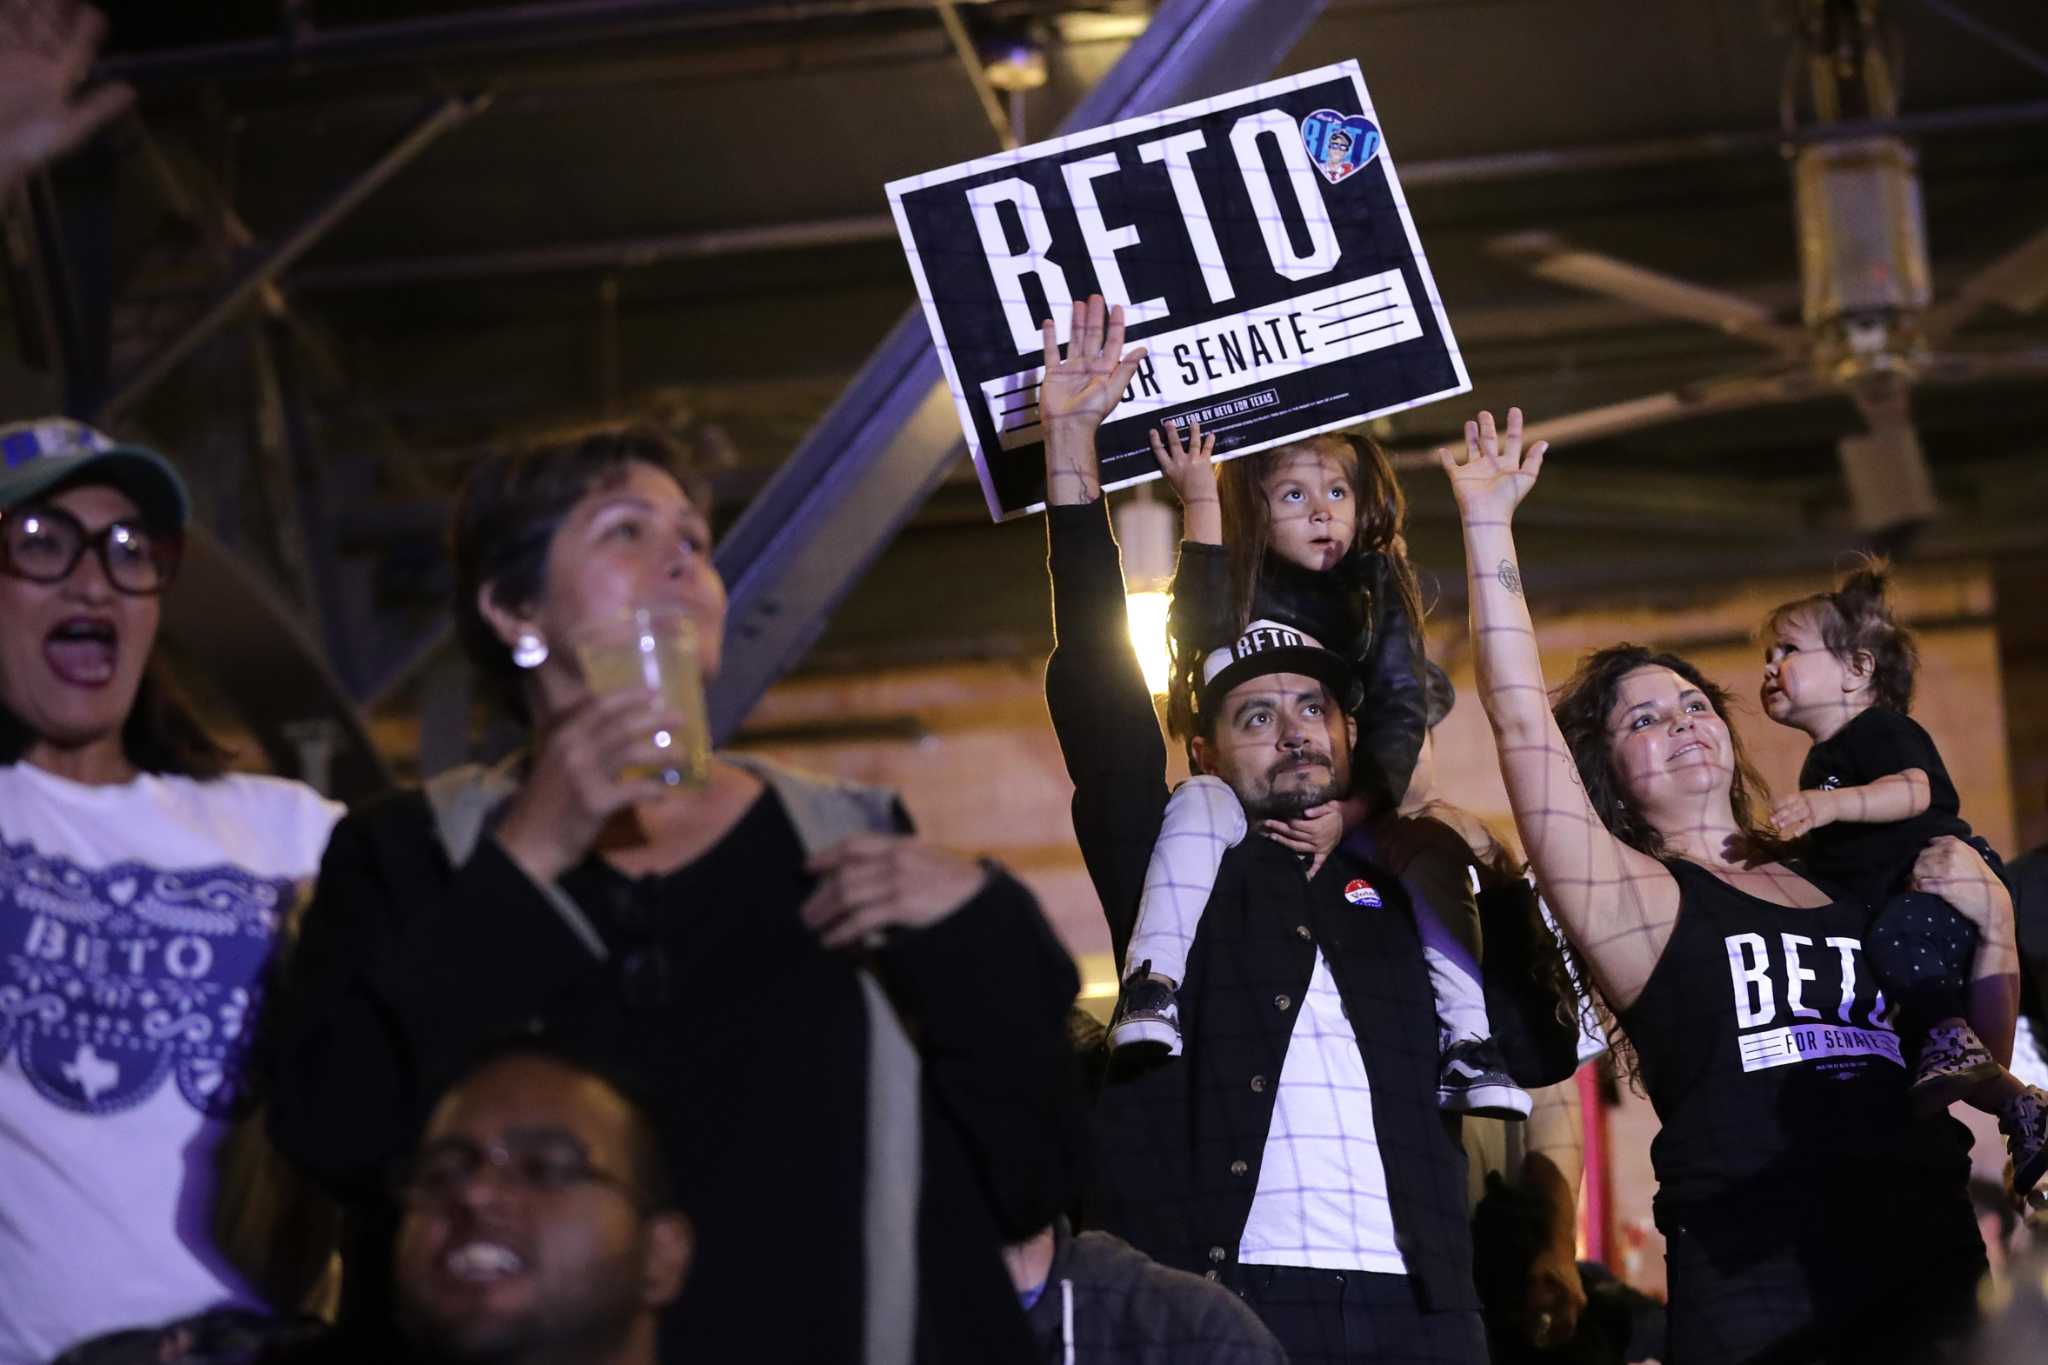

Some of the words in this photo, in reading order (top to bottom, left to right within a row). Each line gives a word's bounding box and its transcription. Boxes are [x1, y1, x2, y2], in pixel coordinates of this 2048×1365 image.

[966, 108, 1342, 356] BETO
[1173, 312, 1314, 386] SENATE
[1201, 409, 1213, 421] BY
[1233, 399, 1249, 412] FOR
[1249, 393, 1274, 408] TEXAS
[25, 914, 213, 980] BETO
[1724, 932, 1895, 1031] BET
[1785, 1031, 1818, 1054] FOR
[1824, 1030, 1880, 1049] SENATE
